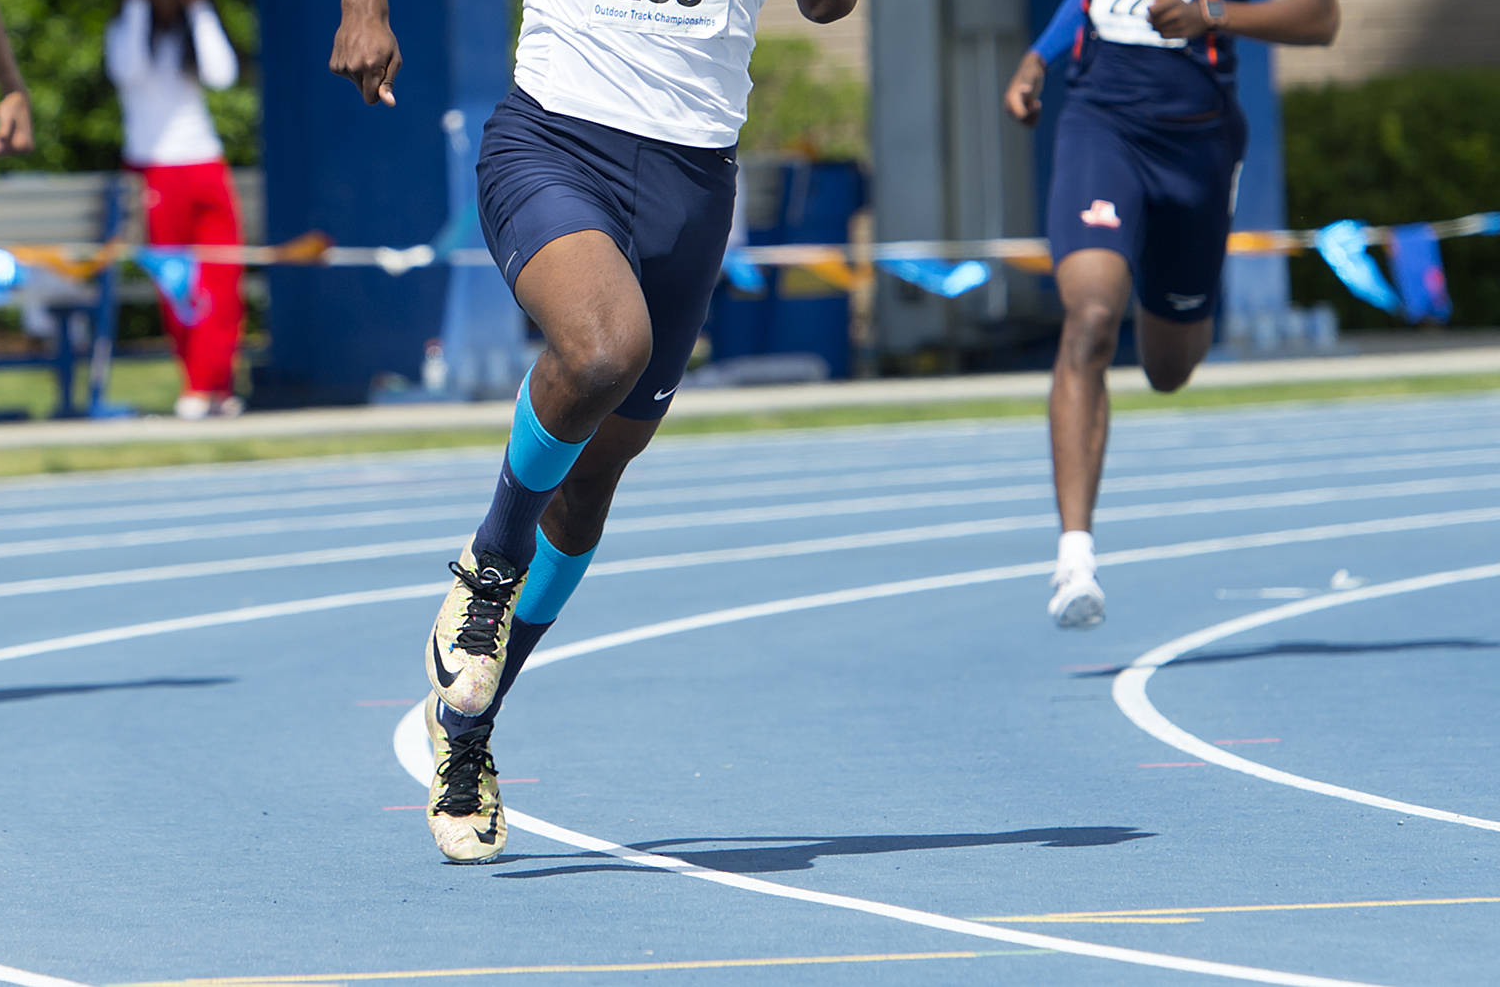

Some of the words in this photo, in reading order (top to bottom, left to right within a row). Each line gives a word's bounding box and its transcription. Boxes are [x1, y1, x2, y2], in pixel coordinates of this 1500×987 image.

[594, 3, 628, 19] Outdoor
[630, 8, 653, 22] Track
[653, 12, 717, 28] Championships
